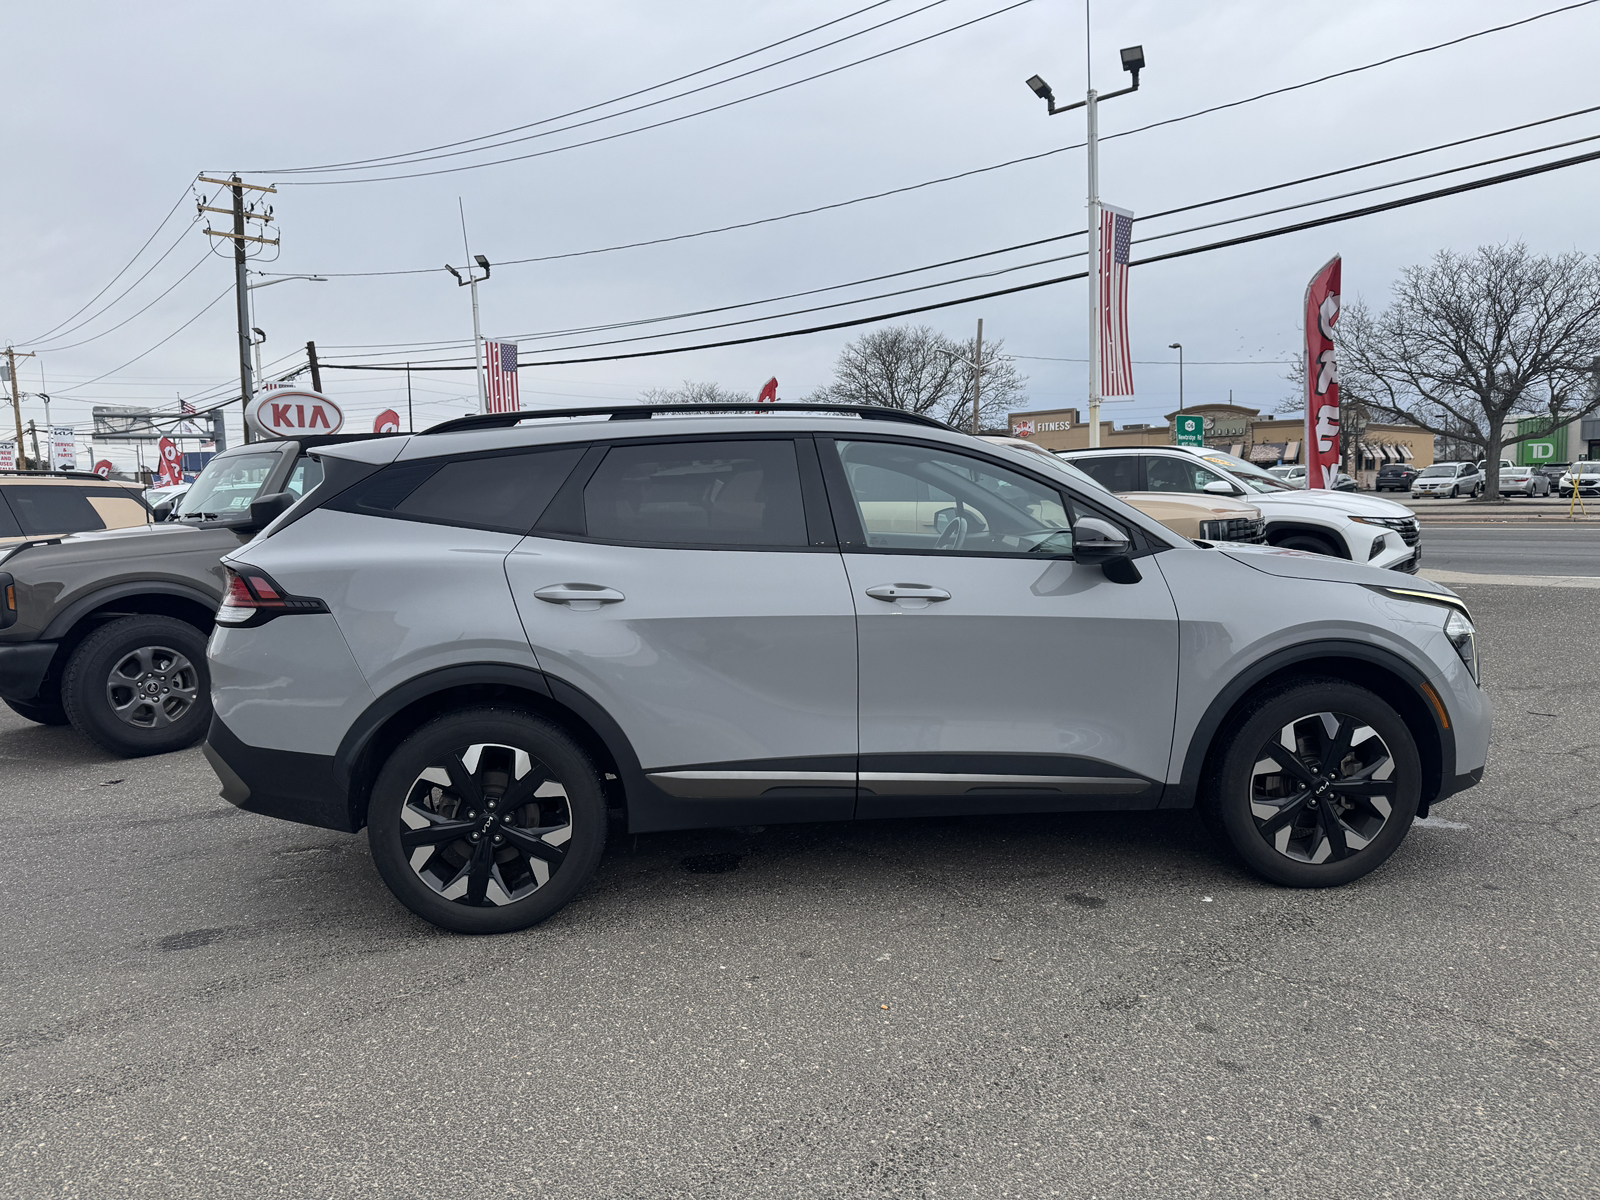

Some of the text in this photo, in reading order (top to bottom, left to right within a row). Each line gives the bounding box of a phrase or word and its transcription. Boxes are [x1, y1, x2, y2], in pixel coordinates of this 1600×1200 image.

[271, 403, 331, 429] KIA
[1037, 421, 1070, 432] FITNESS
[1528, 443, 1554, 458] TD
